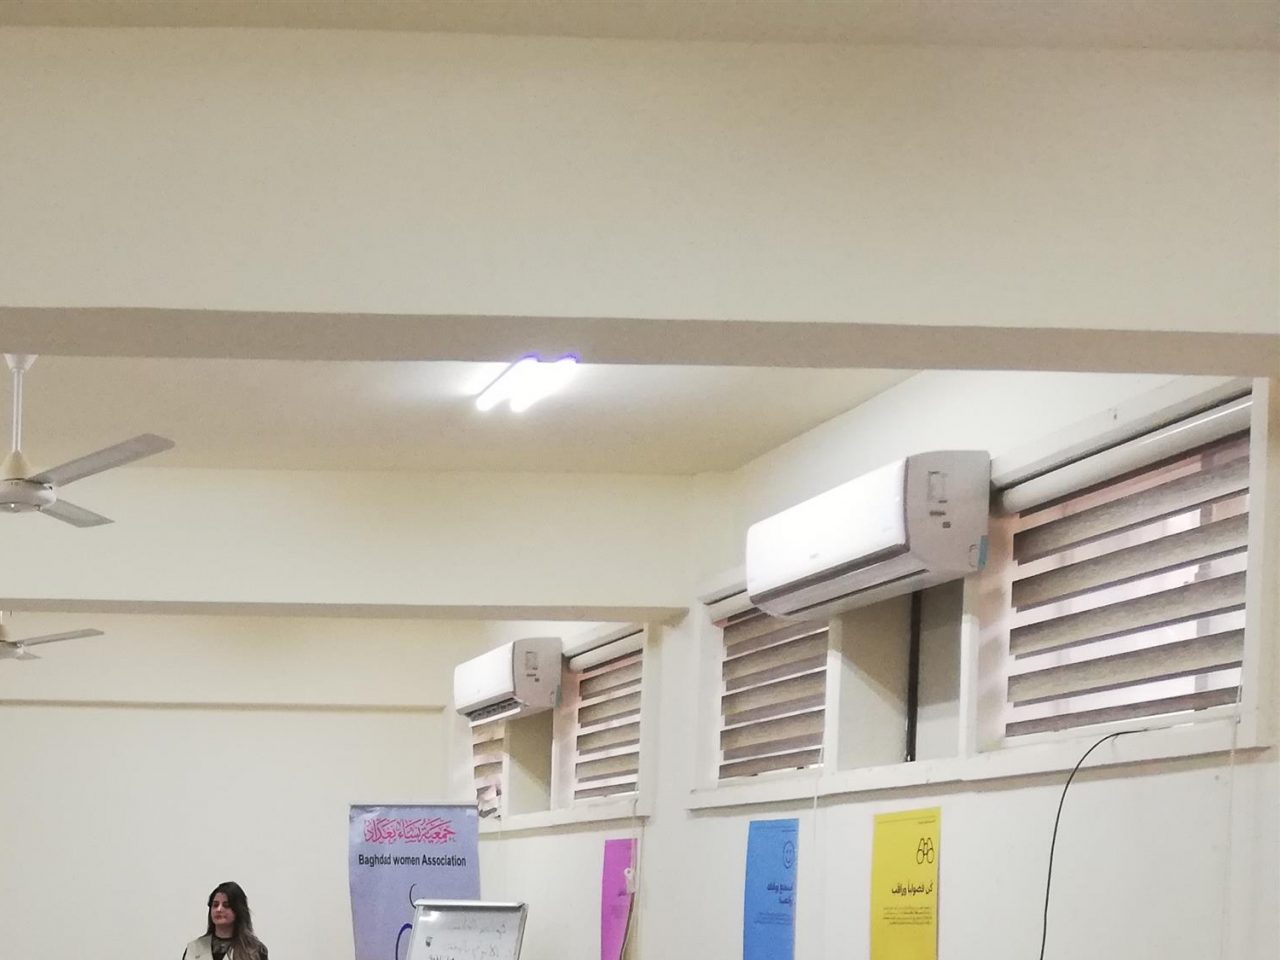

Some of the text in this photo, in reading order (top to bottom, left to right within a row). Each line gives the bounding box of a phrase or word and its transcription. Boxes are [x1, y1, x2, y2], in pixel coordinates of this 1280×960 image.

[358, 854, 467, 867] Baghdad women Association
